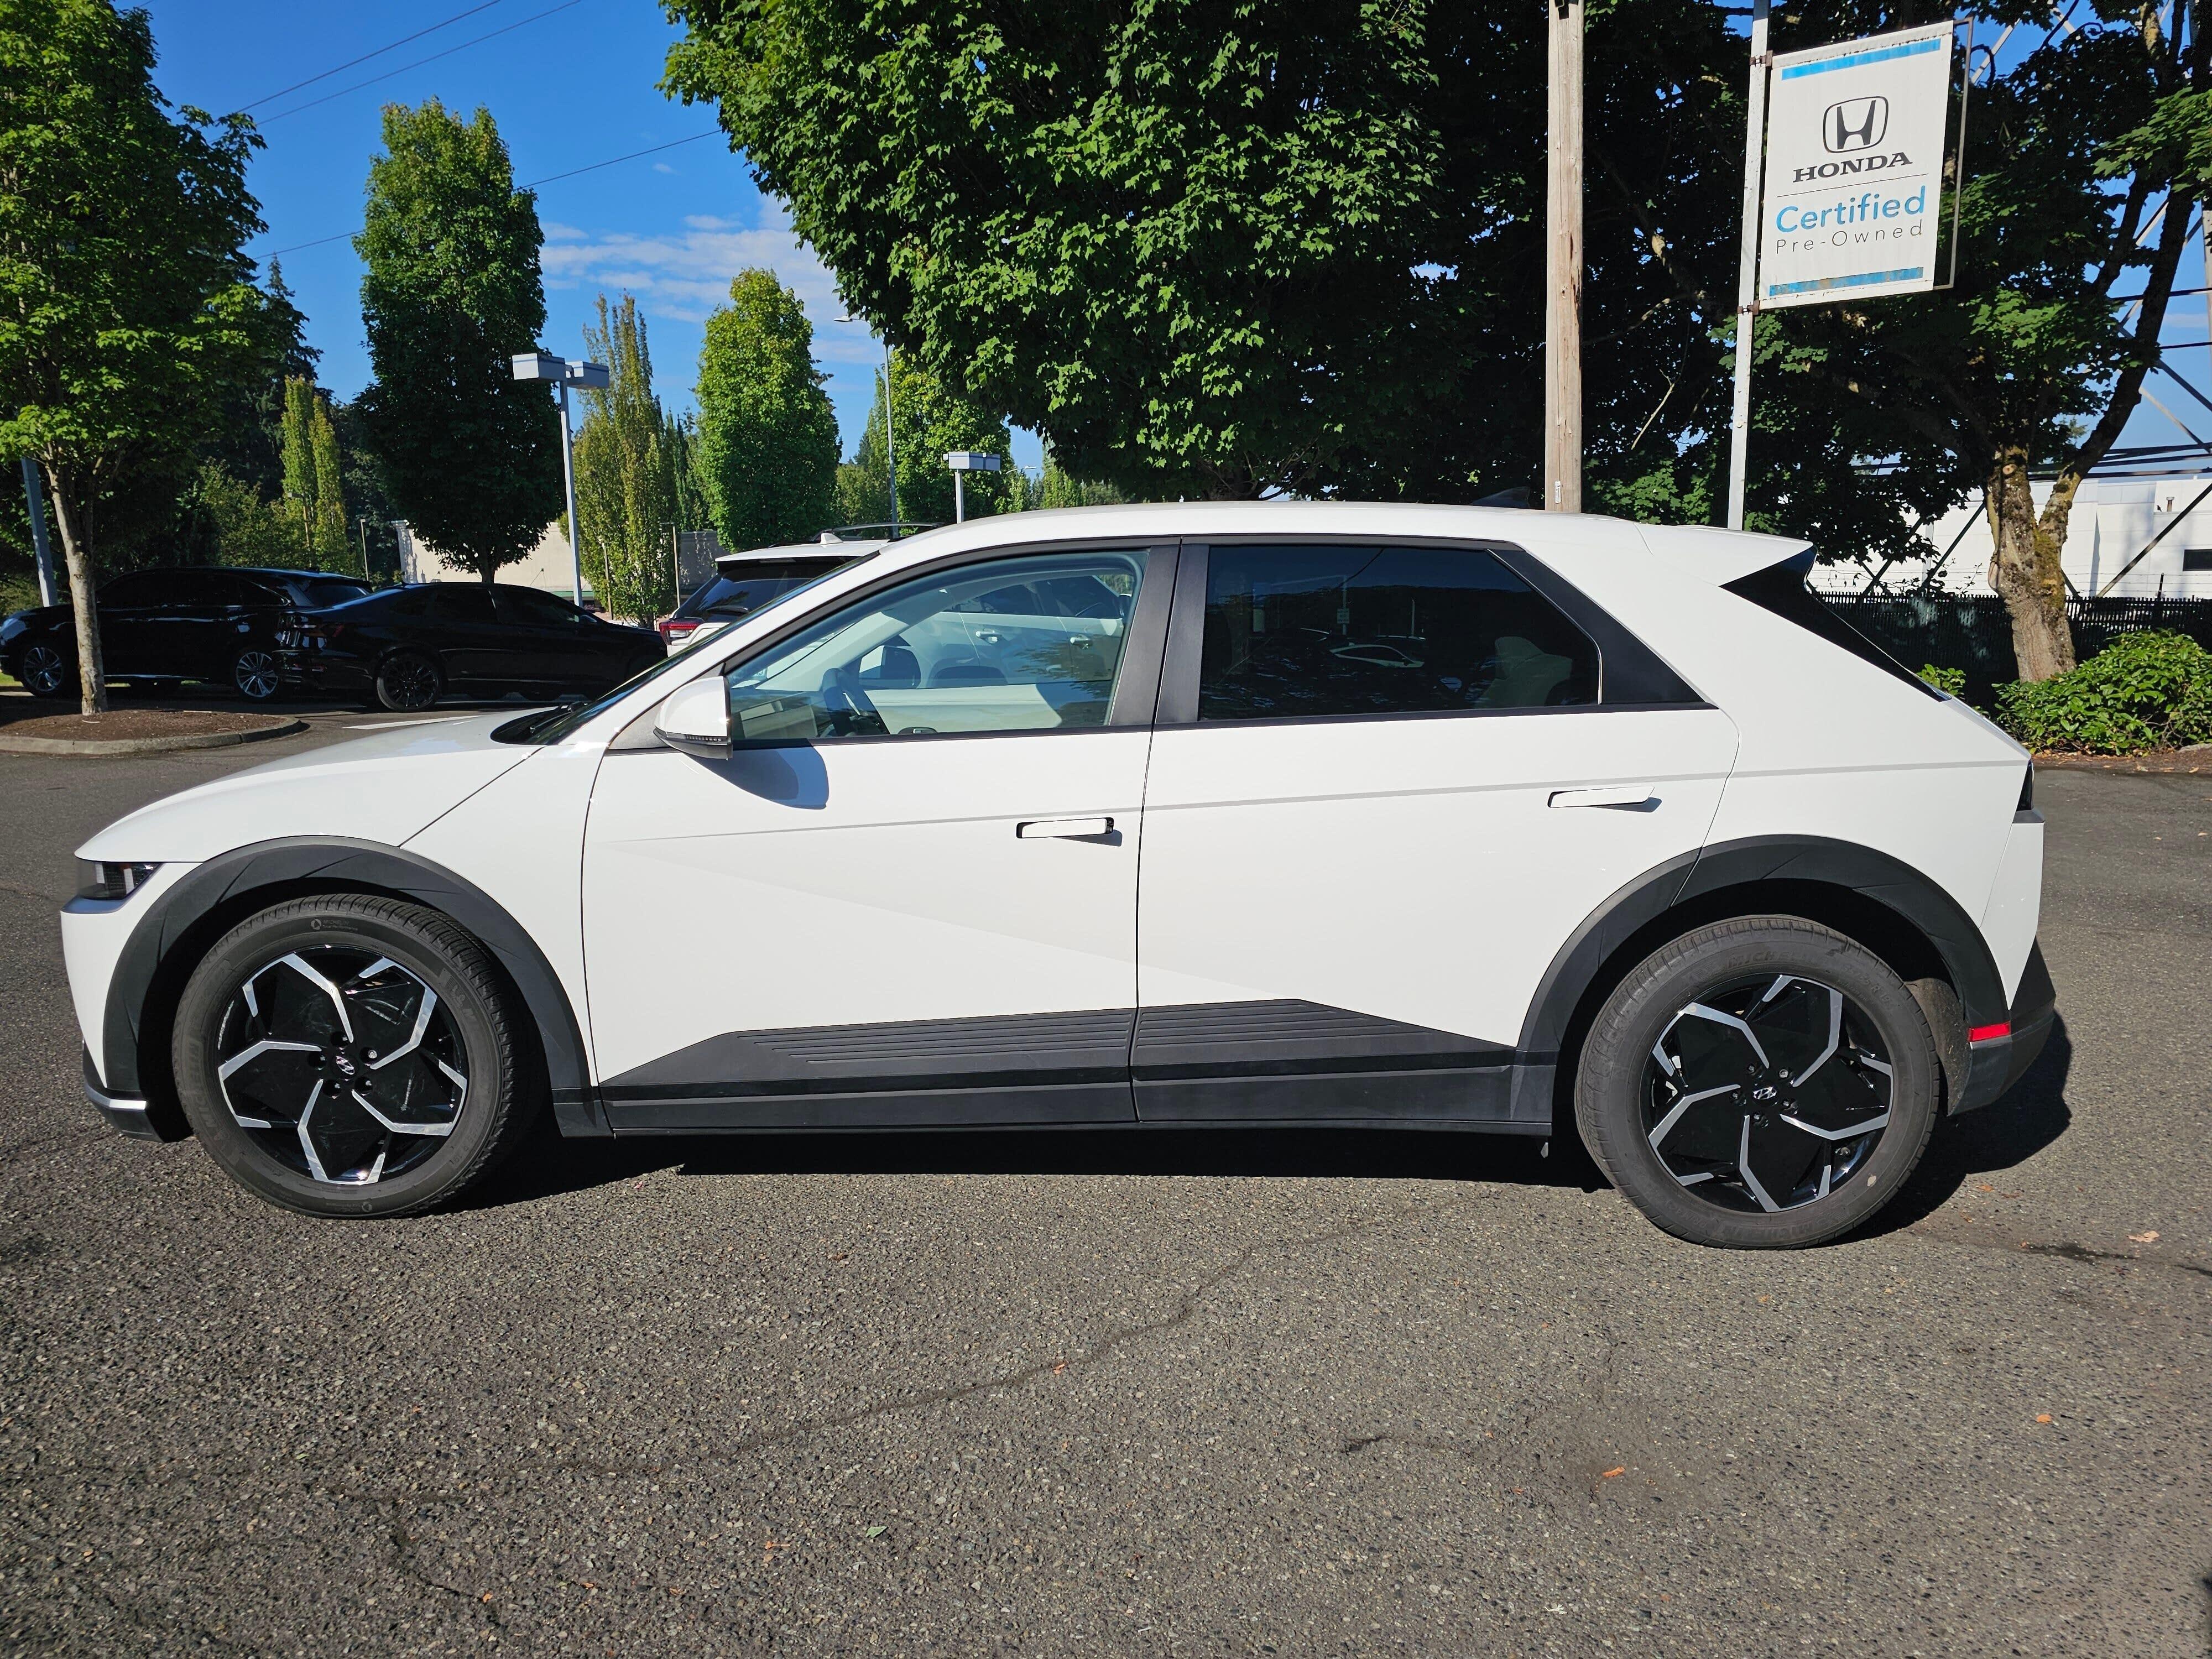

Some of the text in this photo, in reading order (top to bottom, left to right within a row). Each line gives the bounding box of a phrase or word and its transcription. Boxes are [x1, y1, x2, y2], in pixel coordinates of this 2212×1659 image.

[1792, 152, 1913, 183] HONDA
[1776, 185, 1926, 233] Certified
[1776, 219, 1922, 254] Pre-Owned
